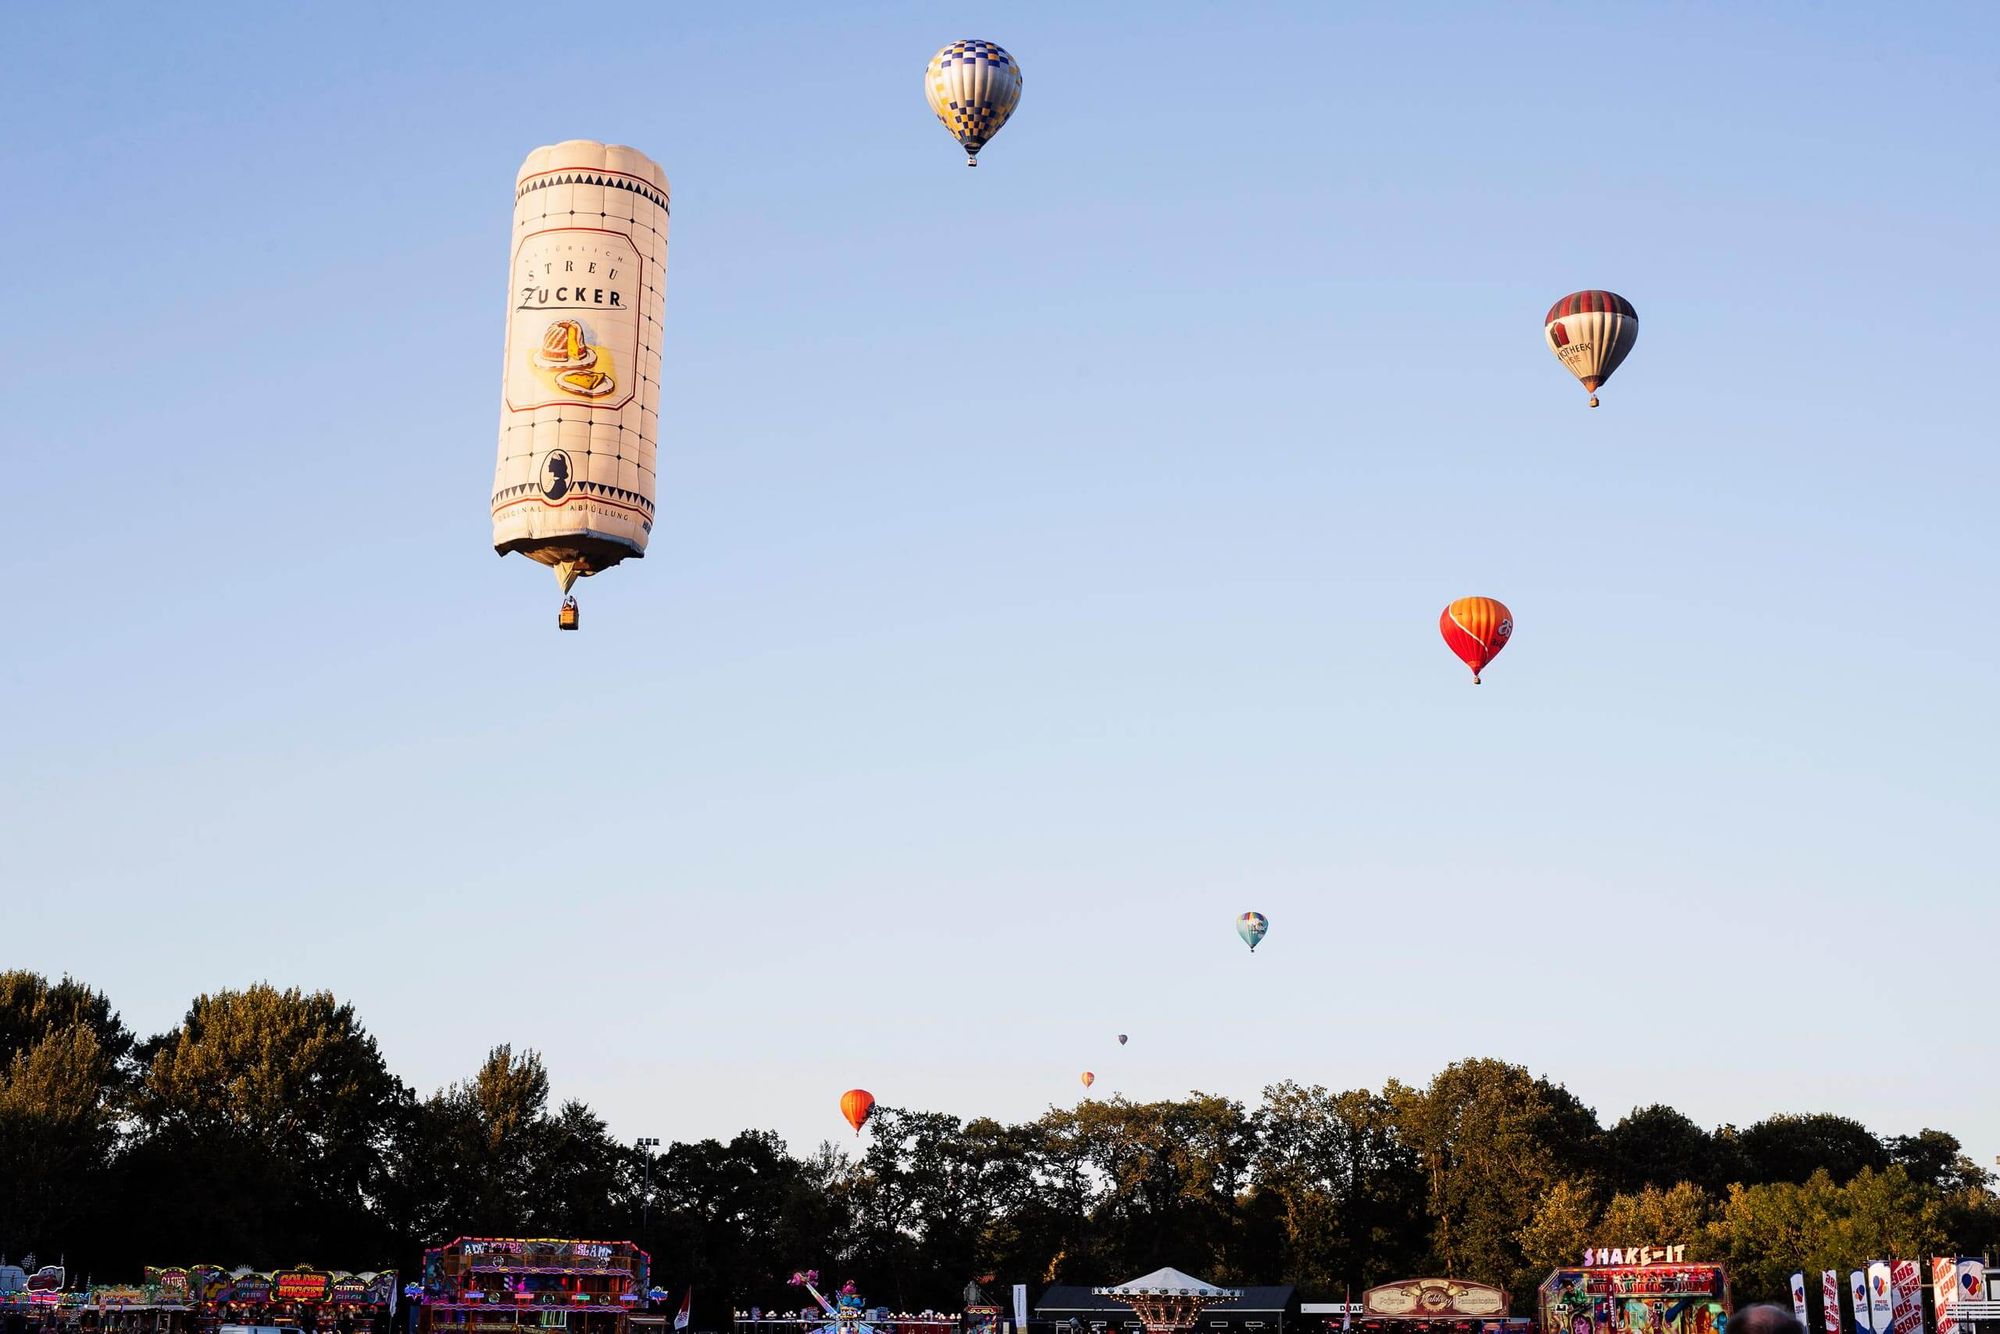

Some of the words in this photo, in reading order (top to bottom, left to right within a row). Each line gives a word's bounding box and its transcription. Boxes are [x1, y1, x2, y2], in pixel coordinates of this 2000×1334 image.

[528, 260, 619, 281] STREU
[517, 286, 627, 311] ZUCKER
[498, 507, 542, 522] ORIGINAL
[570, 504, 629, 521] ABFÜLLUNG
[1584, 1245, 1685, 1266] SHAKE-IT
[280, 1274, 326, 1285] GOLDEN
[1898, 1275, 1920, 1299] 198
[278, 1286, 325, 1297] NUGGET
